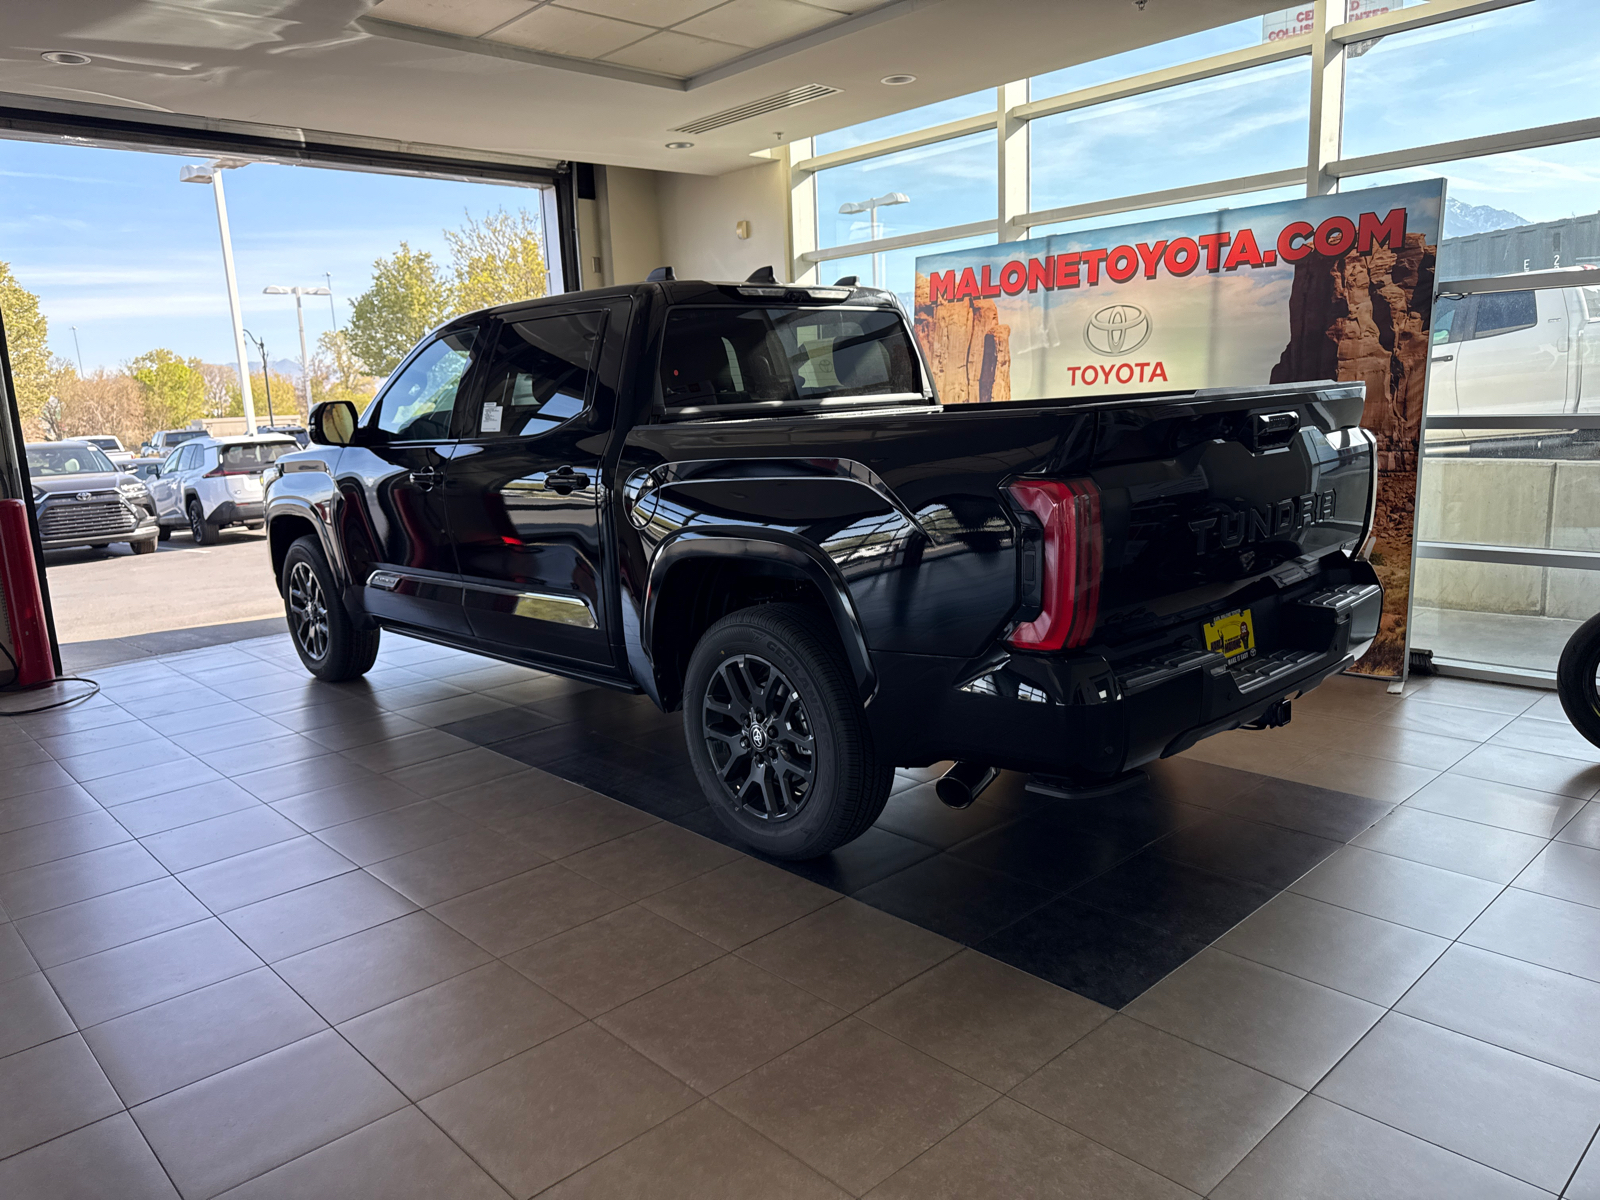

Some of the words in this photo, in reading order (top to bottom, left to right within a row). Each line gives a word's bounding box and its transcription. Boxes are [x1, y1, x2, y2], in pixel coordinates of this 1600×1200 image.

[928, 207, 1407, 301] MALONETOYOTA.COM
[1066, 361, 1169, 387] TOYOTA
[1188, 487, 1337, 556] TUNDRA
